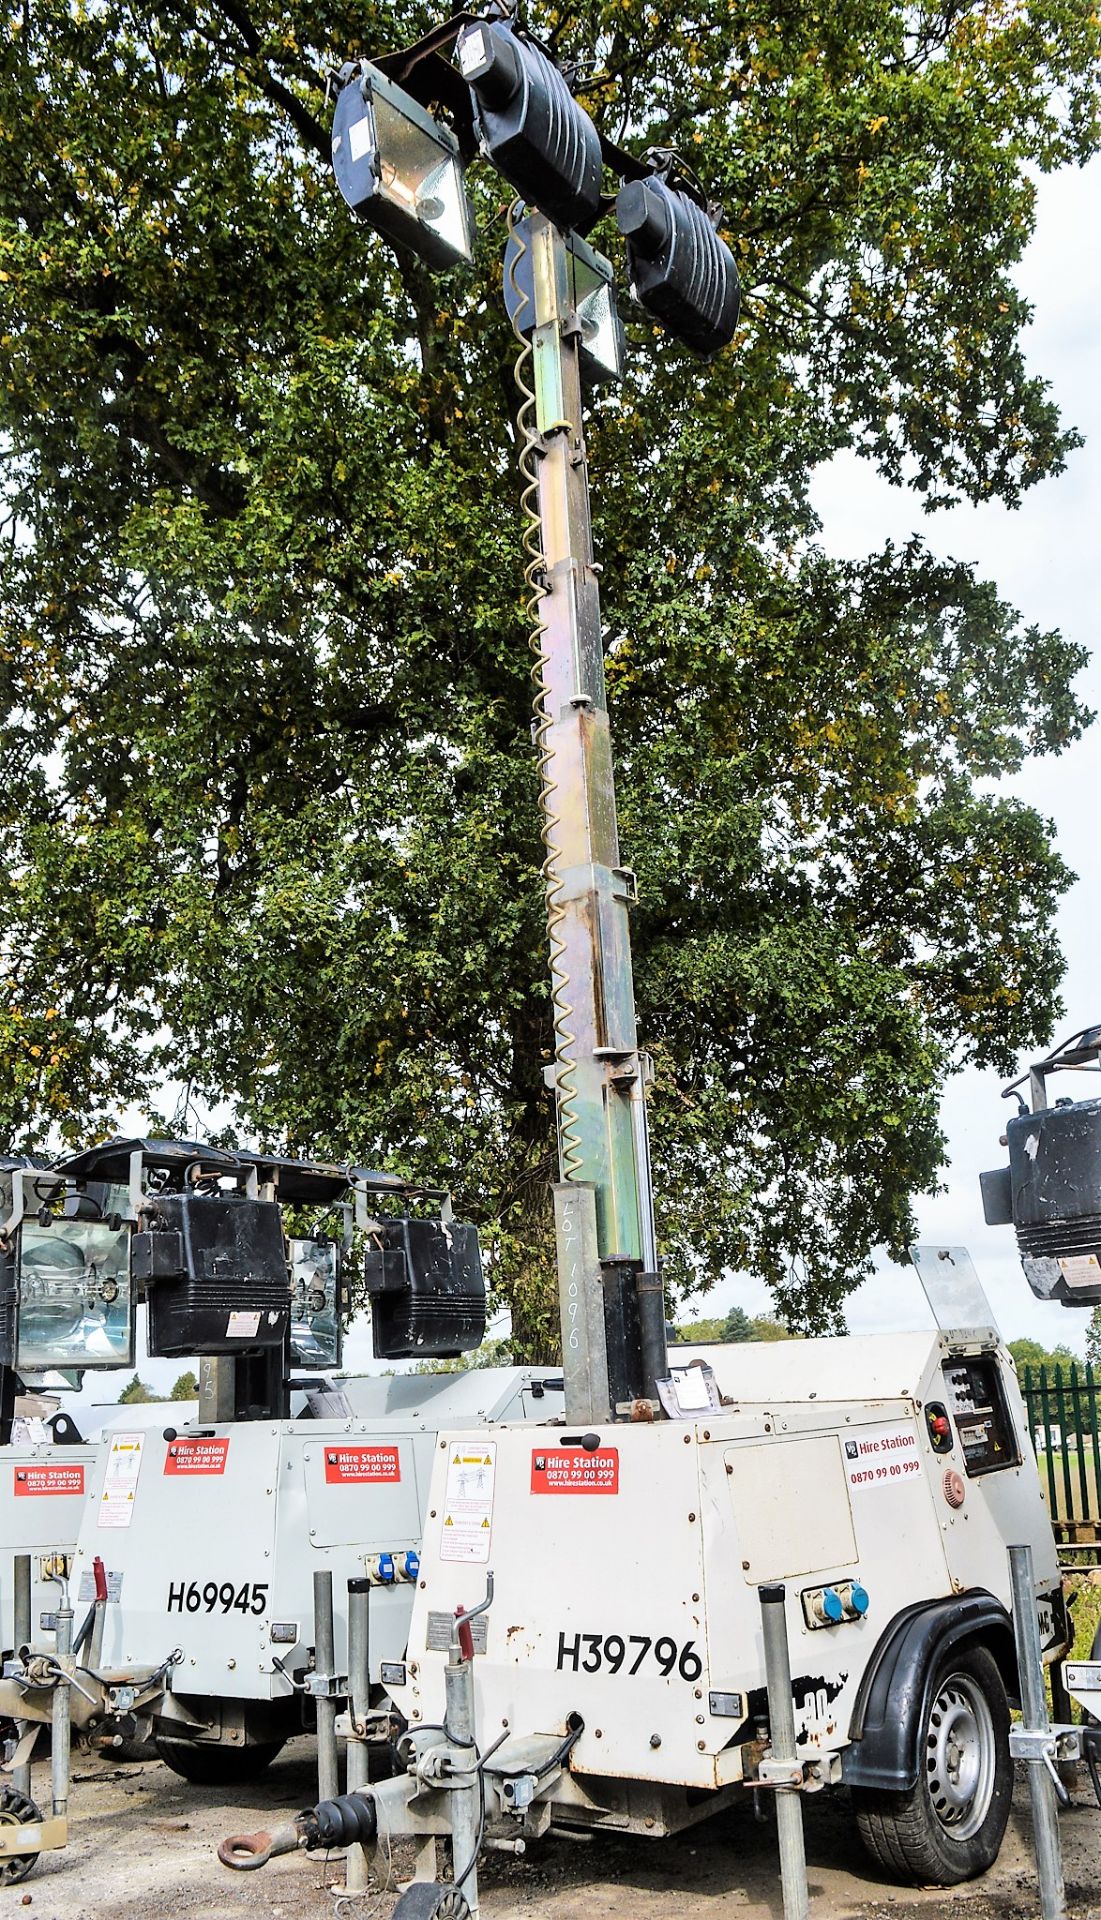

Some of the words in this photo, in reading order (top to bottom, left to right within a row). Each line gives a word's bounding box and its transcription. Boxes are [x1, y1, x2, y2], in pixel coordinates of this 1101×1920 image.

[561, 1203, 577, 1252] LOT
[567, 1263, 580, 1349] 1096
[178, 1446, 194, 1455] Hire
[196, 1445, 224, 1454] Station
[859, 1441, 880, 1454] Hire
[881, 1435, 915, 1450] Station
[340, 1453, 359, 1462] Hire
[362, 1453, 395, 1462] Station
[547, 1457, 570, 1468] Hire
[573, 1456, 614, 1468] Station
[28, 1471, 46, 1479] Hire
[49, 1471, 80, 1479] Station
[547, 1471, 569, 1479] 0870
[571, 1471, 582, 1479] 99
[584, 1470, 595, 1479] 00
[598, 1470, 614, 1478] 999
[851, 1470, 873, 1483] 0870
[876, 1468, 887, 1478] 99
[890, 1465, 901, 1475] 00
[903, 1461, 920, 1472] 999
[168, 1581, 268, 1615] H69945
[556, 1632, 702, 1682] H39796
